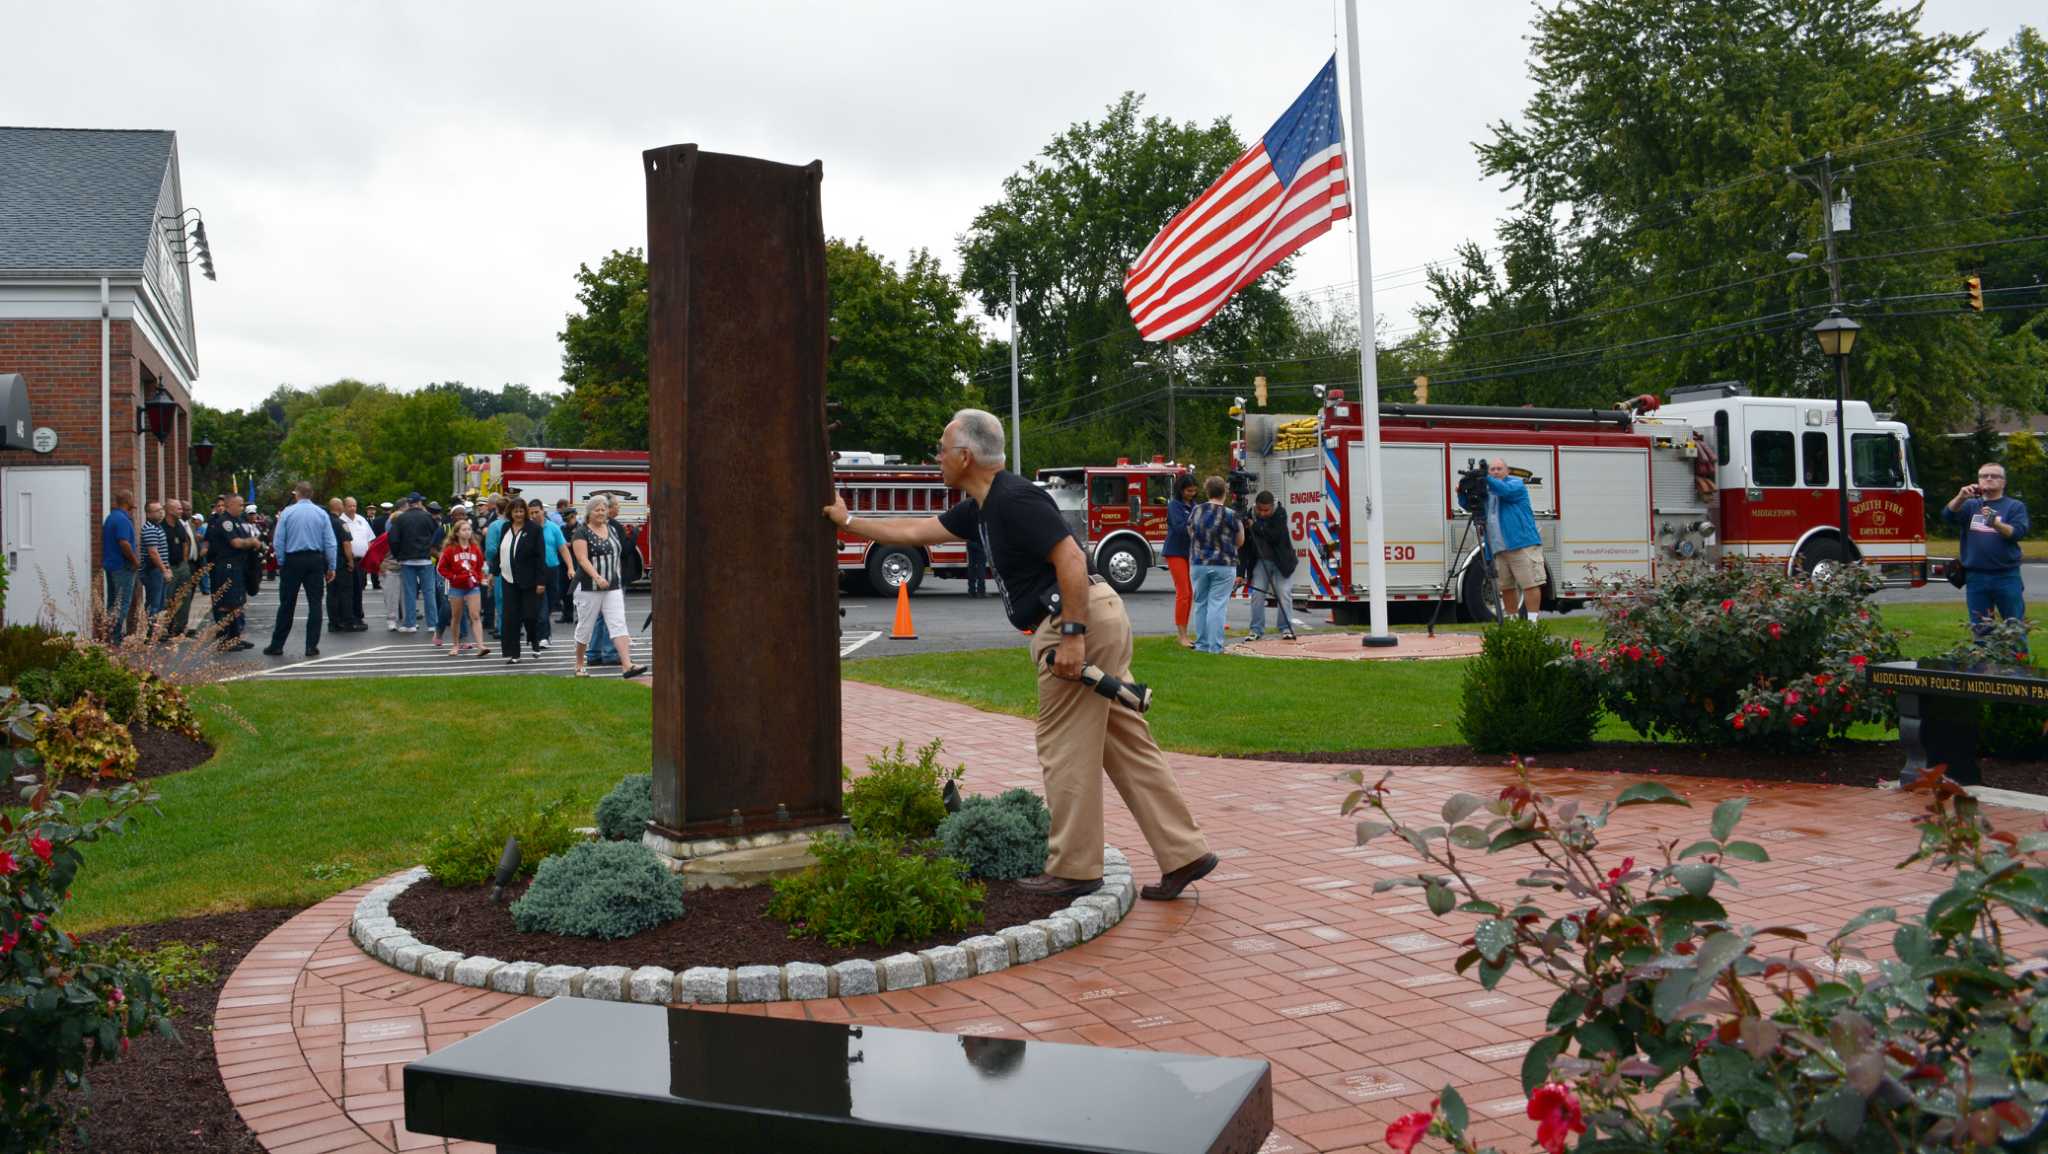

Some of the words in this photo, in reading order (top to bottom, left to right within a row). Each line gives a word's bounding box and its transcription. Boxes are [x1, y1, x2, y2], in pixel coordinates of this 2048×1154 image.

[1289, 491, 1320, 504] ENGINE
[1852, 499, 1882, 516] SOUTH
[1884, 500, 1904, 516] FIRE
[1859, 527, 1899, 536] DISTRICT
[1394, 546, 1415, 560] 30
[1872, 672, 1928, 688] MIDDLETOWN
[1930, 676, 1960, 691] POLICE
[1967, 680, 2028, 696] MIDDLETOWN
